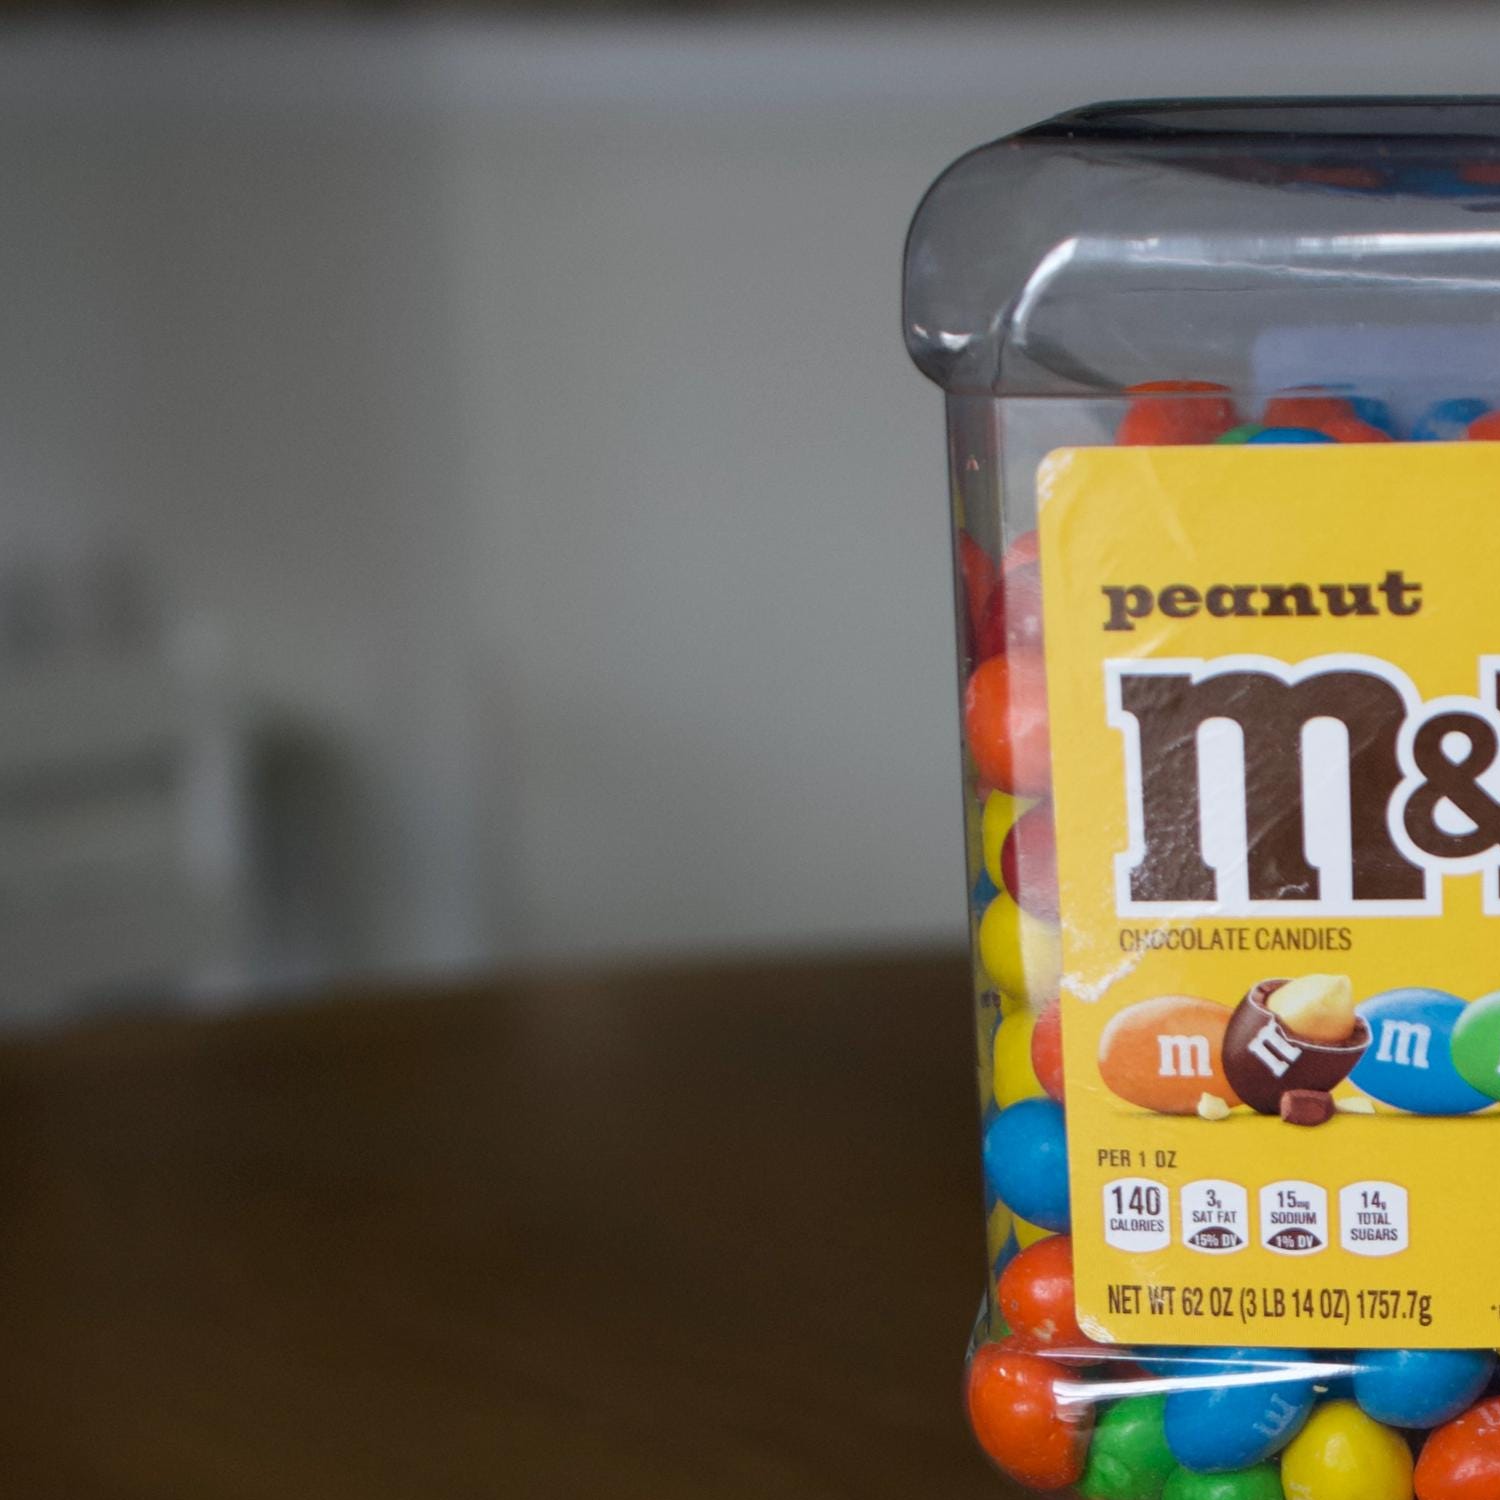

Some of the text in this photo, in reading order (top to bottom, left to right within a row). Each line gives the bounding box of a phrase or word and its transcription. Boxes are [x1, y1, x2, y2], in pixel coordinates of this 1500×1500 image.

[1102, 571, 1423, 631] peanut
[1119, 926, 1353, 951] CHOCOLATE CANDIES
[1098, 1149, 1178, 1168] PER 1 OZ
[1112, 1186, 1161, 1216] 140
[1193, 1210, 1238, 1224] SAT FAT
[1271, 1212, 1317, 1225] SODIUM
[1357, 1212, 1391, 1225] TOTAL
[1110, 1218, 1165, 1232] CALORIES
[1195, 1233, 1219, 1247] 15%
[1275, 1235, 1313, 1248] 1% DV
[1351, 1228, 1398, 1241] SUGARS
[1108, 1285, 1433, 1326] NET WT 62 OZ (3 LB 14 OZ) 1757.7g
